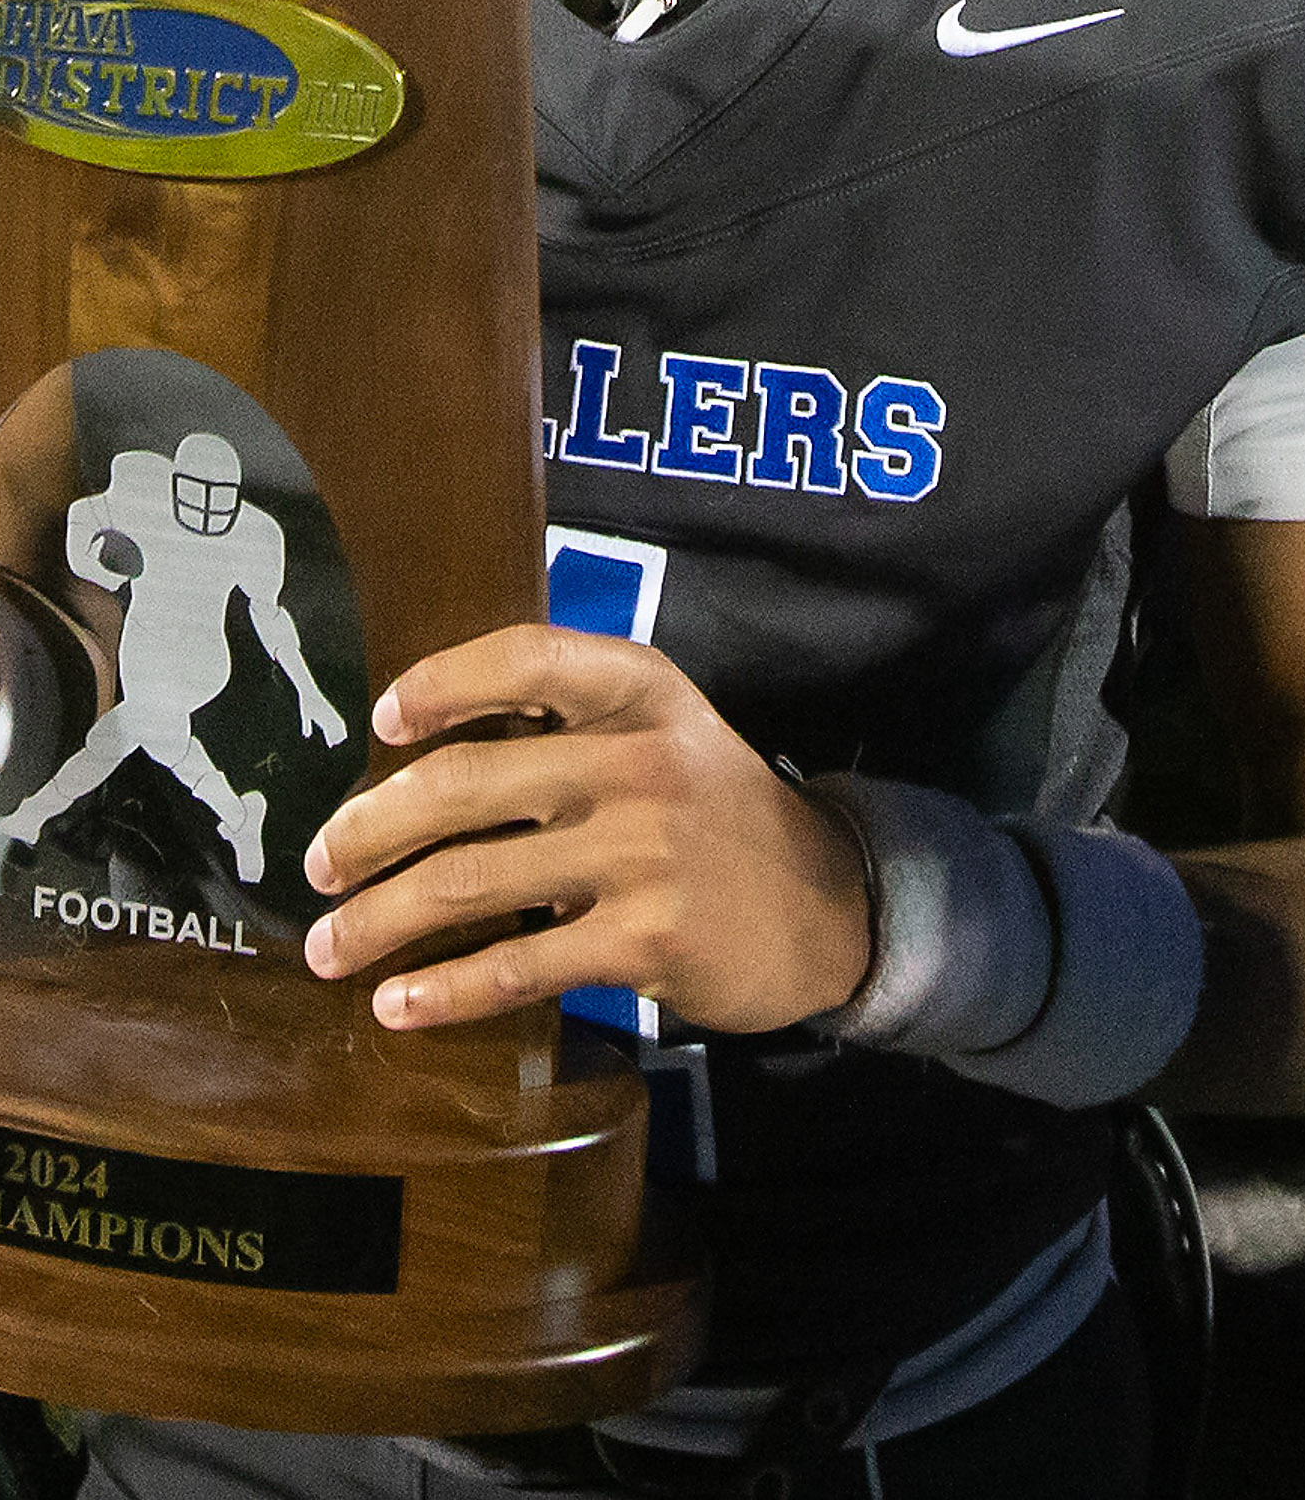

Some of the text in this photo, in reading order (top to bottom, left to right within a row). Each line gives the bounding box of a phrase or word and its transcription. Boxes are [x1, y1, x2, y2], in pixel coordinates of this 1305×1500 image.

[543, 338, 947, 502] LERS
[33, 885, 258, 956] FOOTBALL
[5, 1142, 110, 1200] 2024
